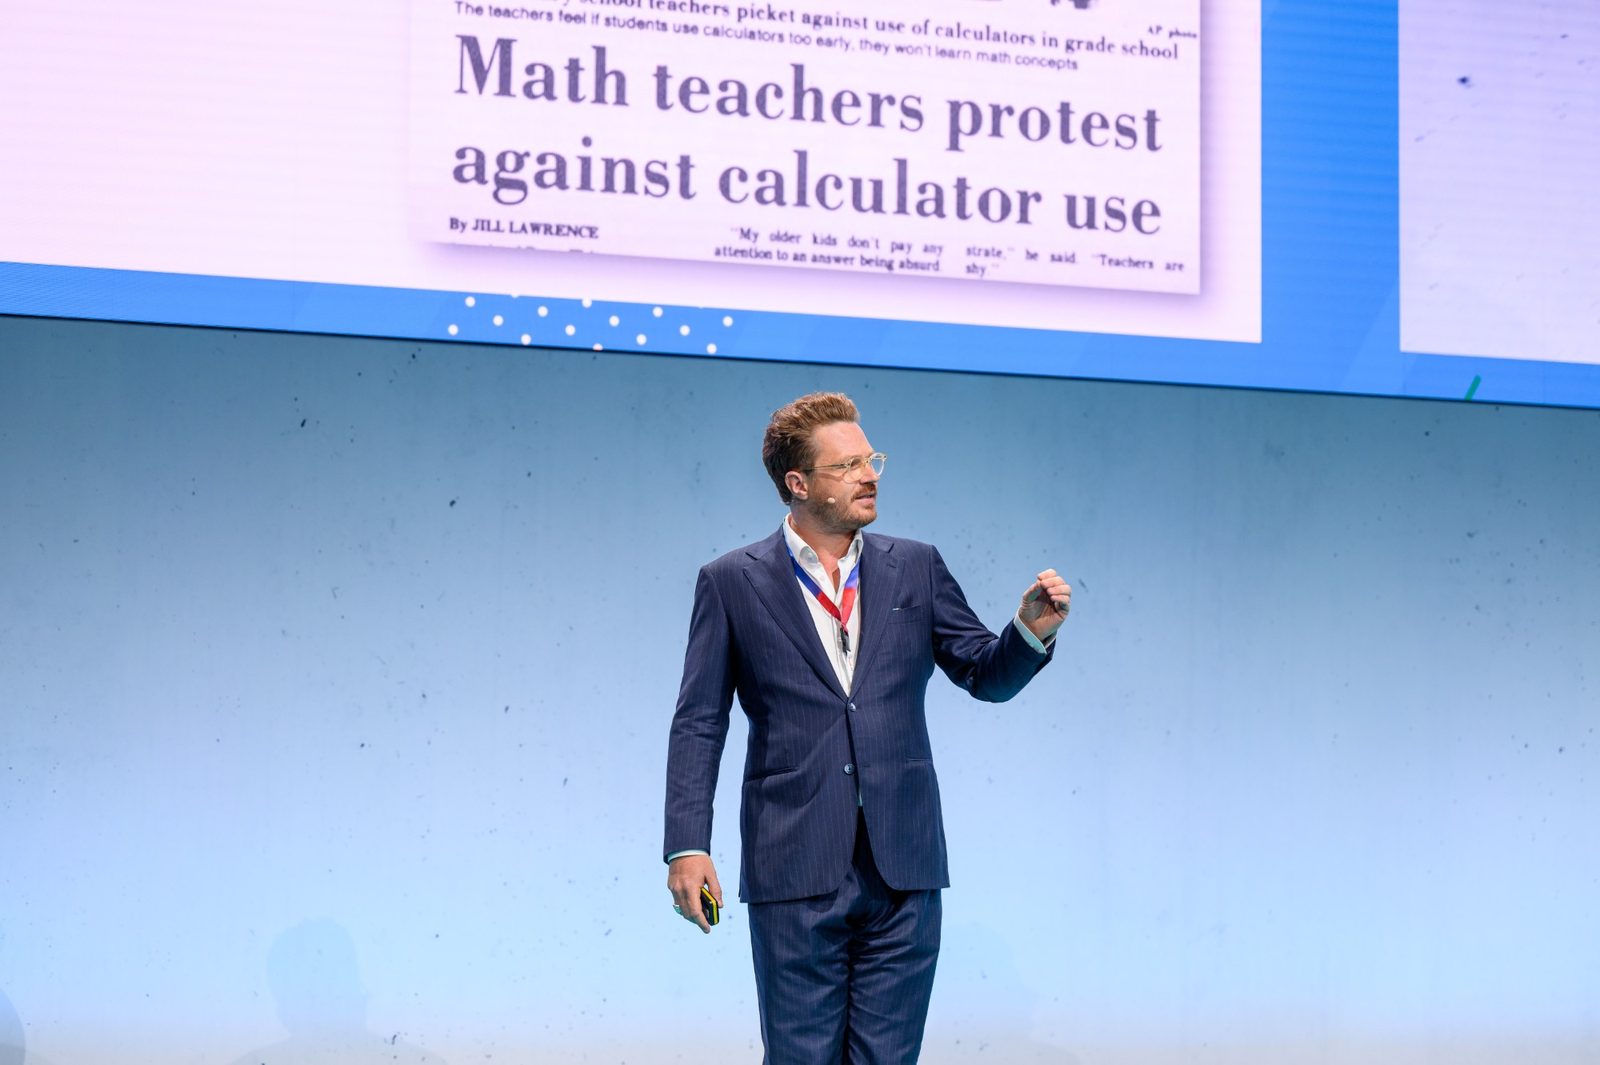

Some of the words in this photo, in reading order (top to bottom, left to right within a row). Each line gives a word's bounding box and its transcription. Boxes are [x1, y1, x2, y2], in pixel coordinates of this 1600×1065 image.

[455, 1, 484, 17] The
[488, 5, 554, 22] teachers
[558, 10, 587, 25] feel
[591, 12, 600, 25] if
[603, 16, 668, 32] students
[672, 23, 700, 35] use
[703, 24, 785, 44] calculators
[789, 32, 812, 46] too
[859, 39, 890, 56] they
[895, 45, 932, 57] won't
[935, 46, 972, 60] learn
[976, 50, 1012, 65] math
[1014, 53, 1079, 71] concepts
[648, 0, 730, 16] teachers
[736, 4, 796, 22] picket
[801, 11, 869, 30] against
[875, 18, 906, 33] use
[911, 19, 930, 36] of
[935, 22, 1036, 46] calculators
[1042, 31, 1059, 48] in
[1065, 36, 1116, 54] grade
[1121, 40, 1179, 60] school
[454, 34, 630, 107] Math
[652, 63, 925, 133] teachers
[946, 99, 1163, 153] protest
[452, 136, 697, 206] against
[717, 149, 1043, 226] calculator
[1062, 193, 1162, 235] use
[449, 217, 468, 233] By
[472, 219, 506, 234] JILL
[508, 221, 600, 240] LAWRENCE
[769, 231, 802, 245] older
[812, 233, 838, 247] kids
[847, 236, 880, 250] don't
[890, 241, 913, 255] pay
[922, 243, 944, 257] any
[713, 246, 773, 261] attention
[776, 249, 789, 263] to
[792, 252, 808, 263] an
[811, 253, 856, 267] answer
[859, 254, 895, 273] being
[1025, 248, 1040, 262] he
[1165, 261, 1185, 273] are
